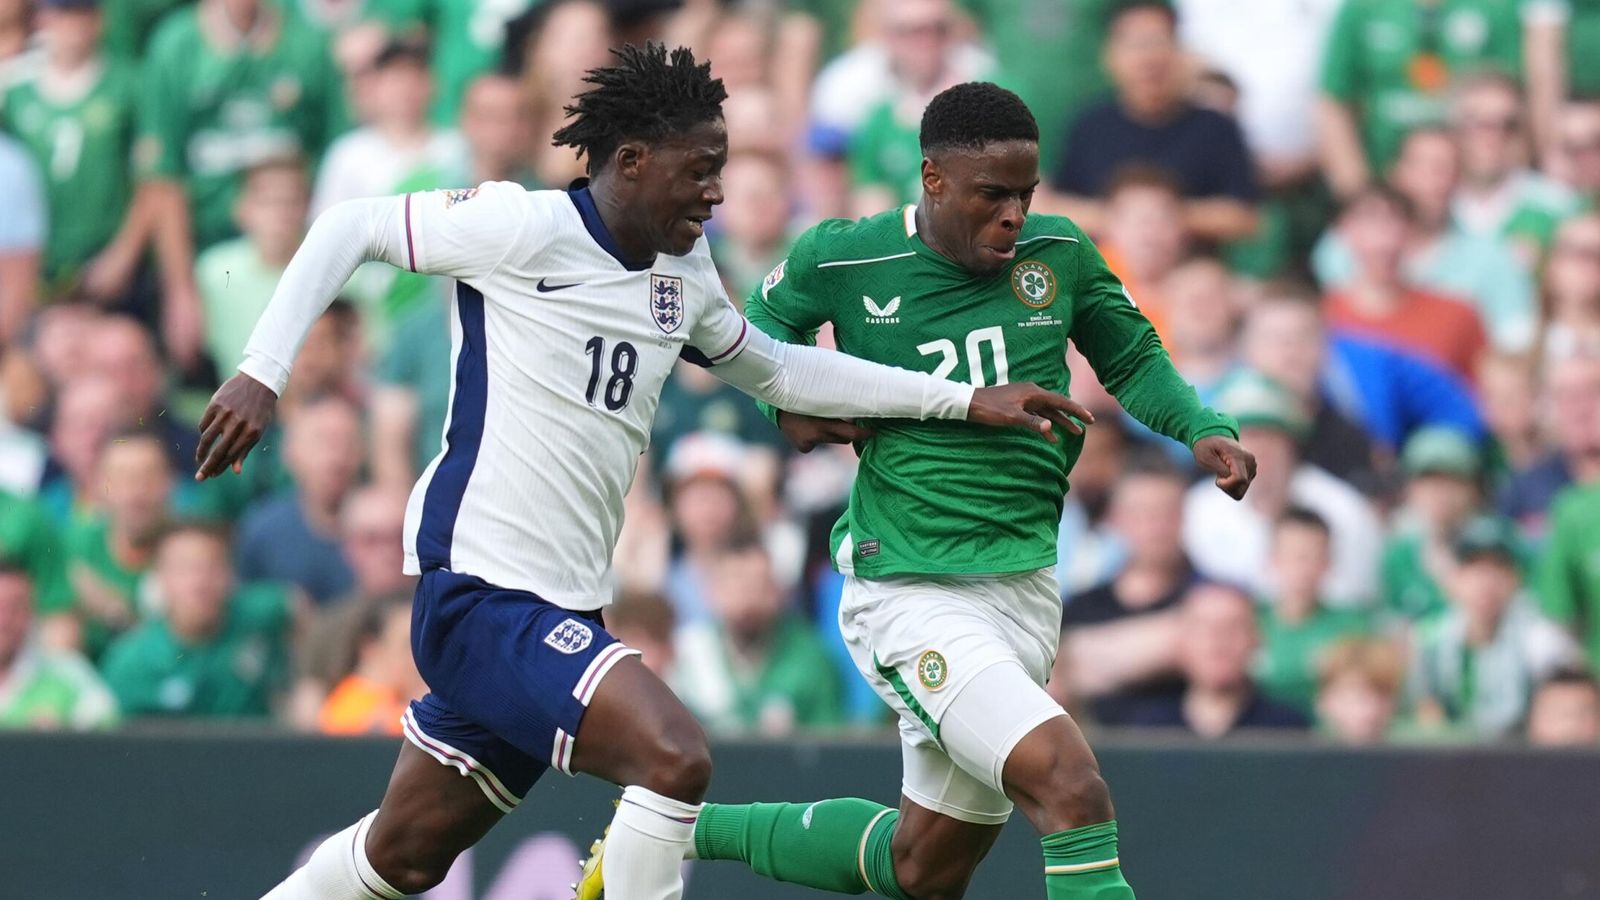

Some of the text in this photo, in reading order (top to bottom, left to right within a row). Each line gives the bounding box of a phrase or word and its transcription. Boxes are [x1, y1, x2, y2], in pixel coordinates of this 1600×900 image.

[1014, 264, 1050, 280] IRELAND
[585, 336, 639, 413] 18
[916, 325, 1009, 388] 20
